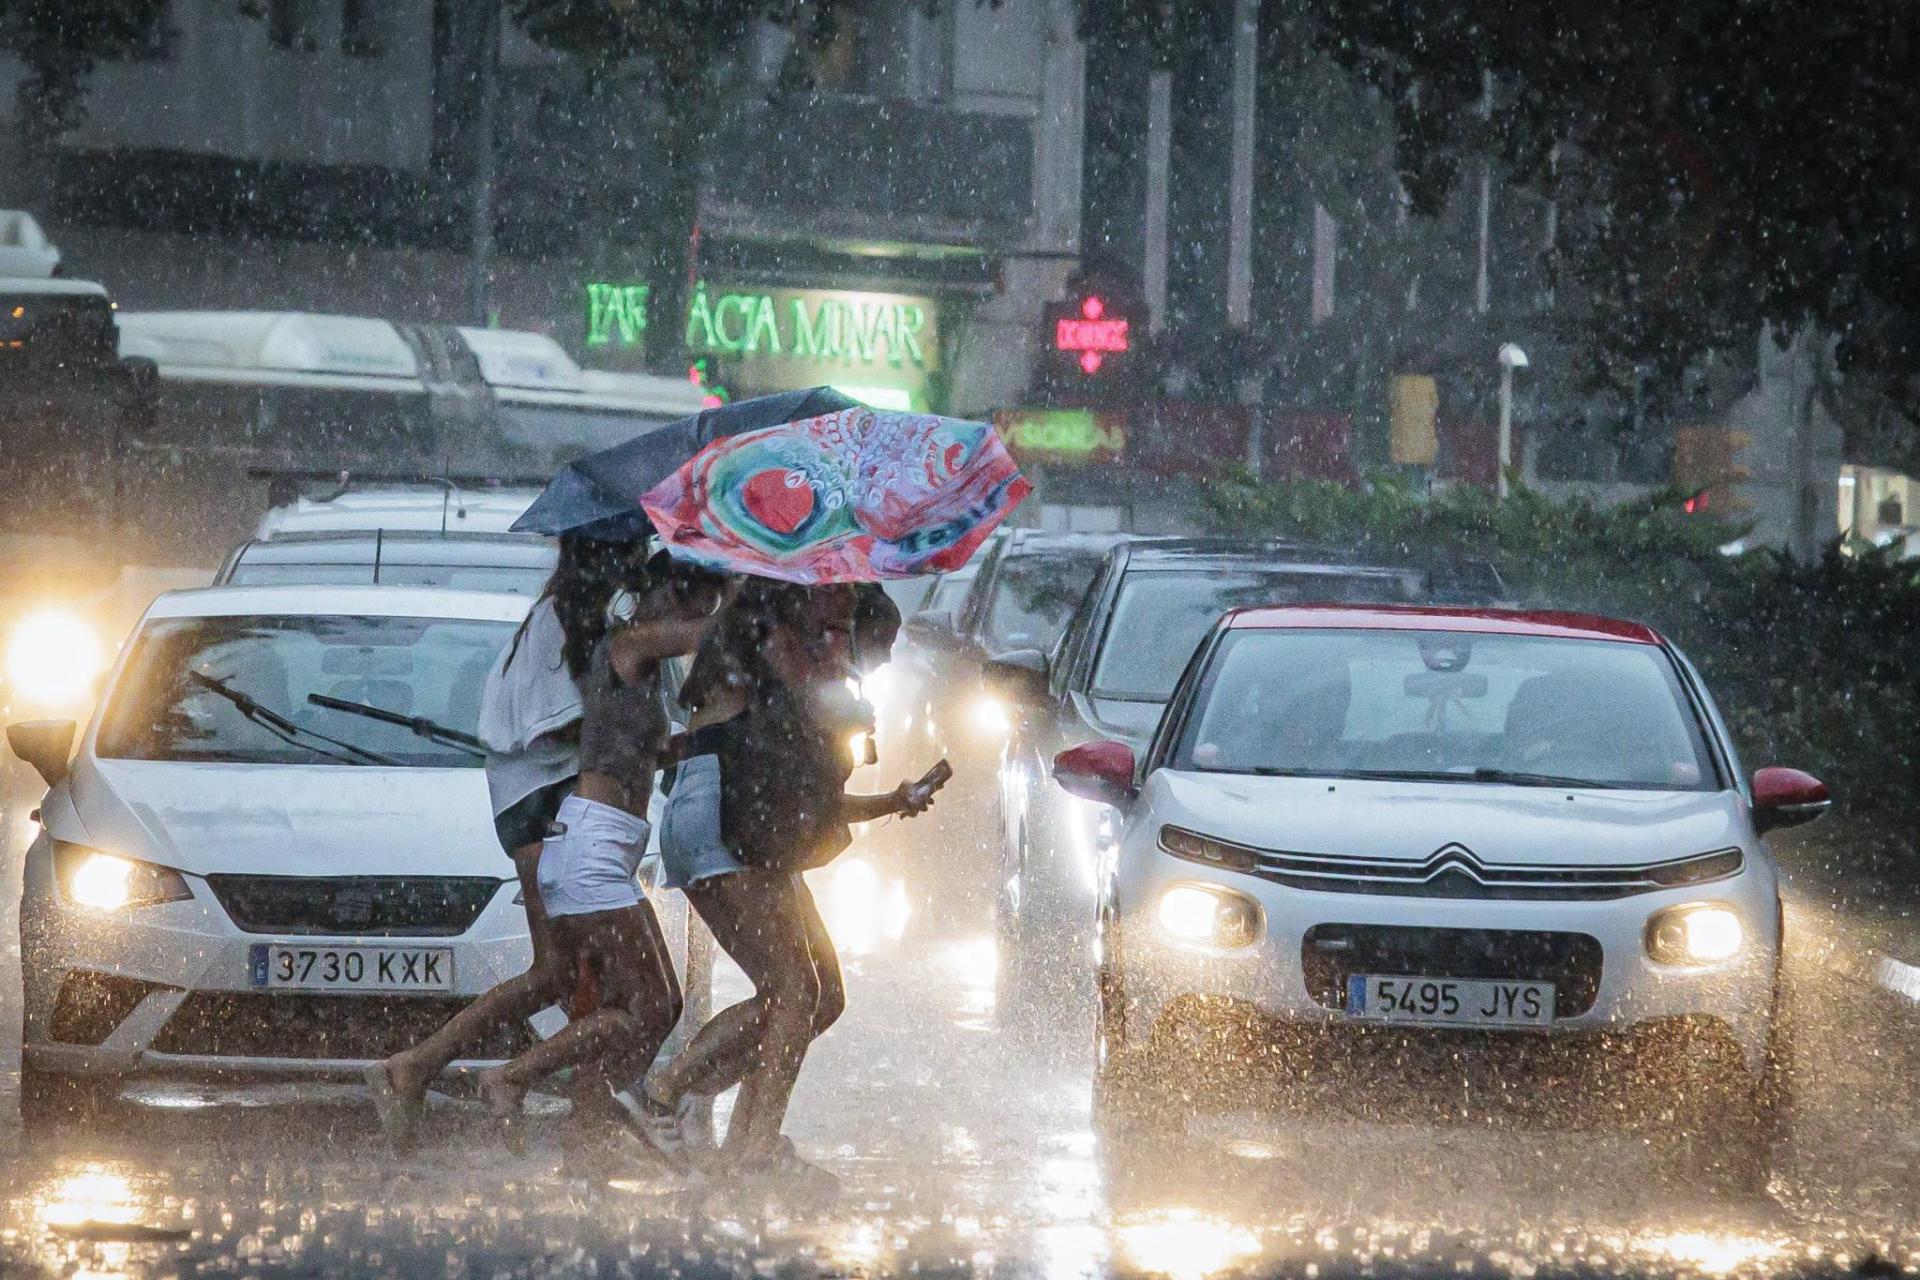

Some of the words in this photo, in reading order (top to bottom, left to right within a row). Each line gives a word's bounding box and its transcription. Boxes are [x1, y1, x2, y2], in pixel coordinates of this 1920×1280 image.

[790, 298, 926, 366] MINAR
[277, 951, 364, 983] 3730
[378, 951, 442, 984] KXK
[1378, 981, 1460, 1016] 5495
[1480, 985, 1541, 1018] JYS
